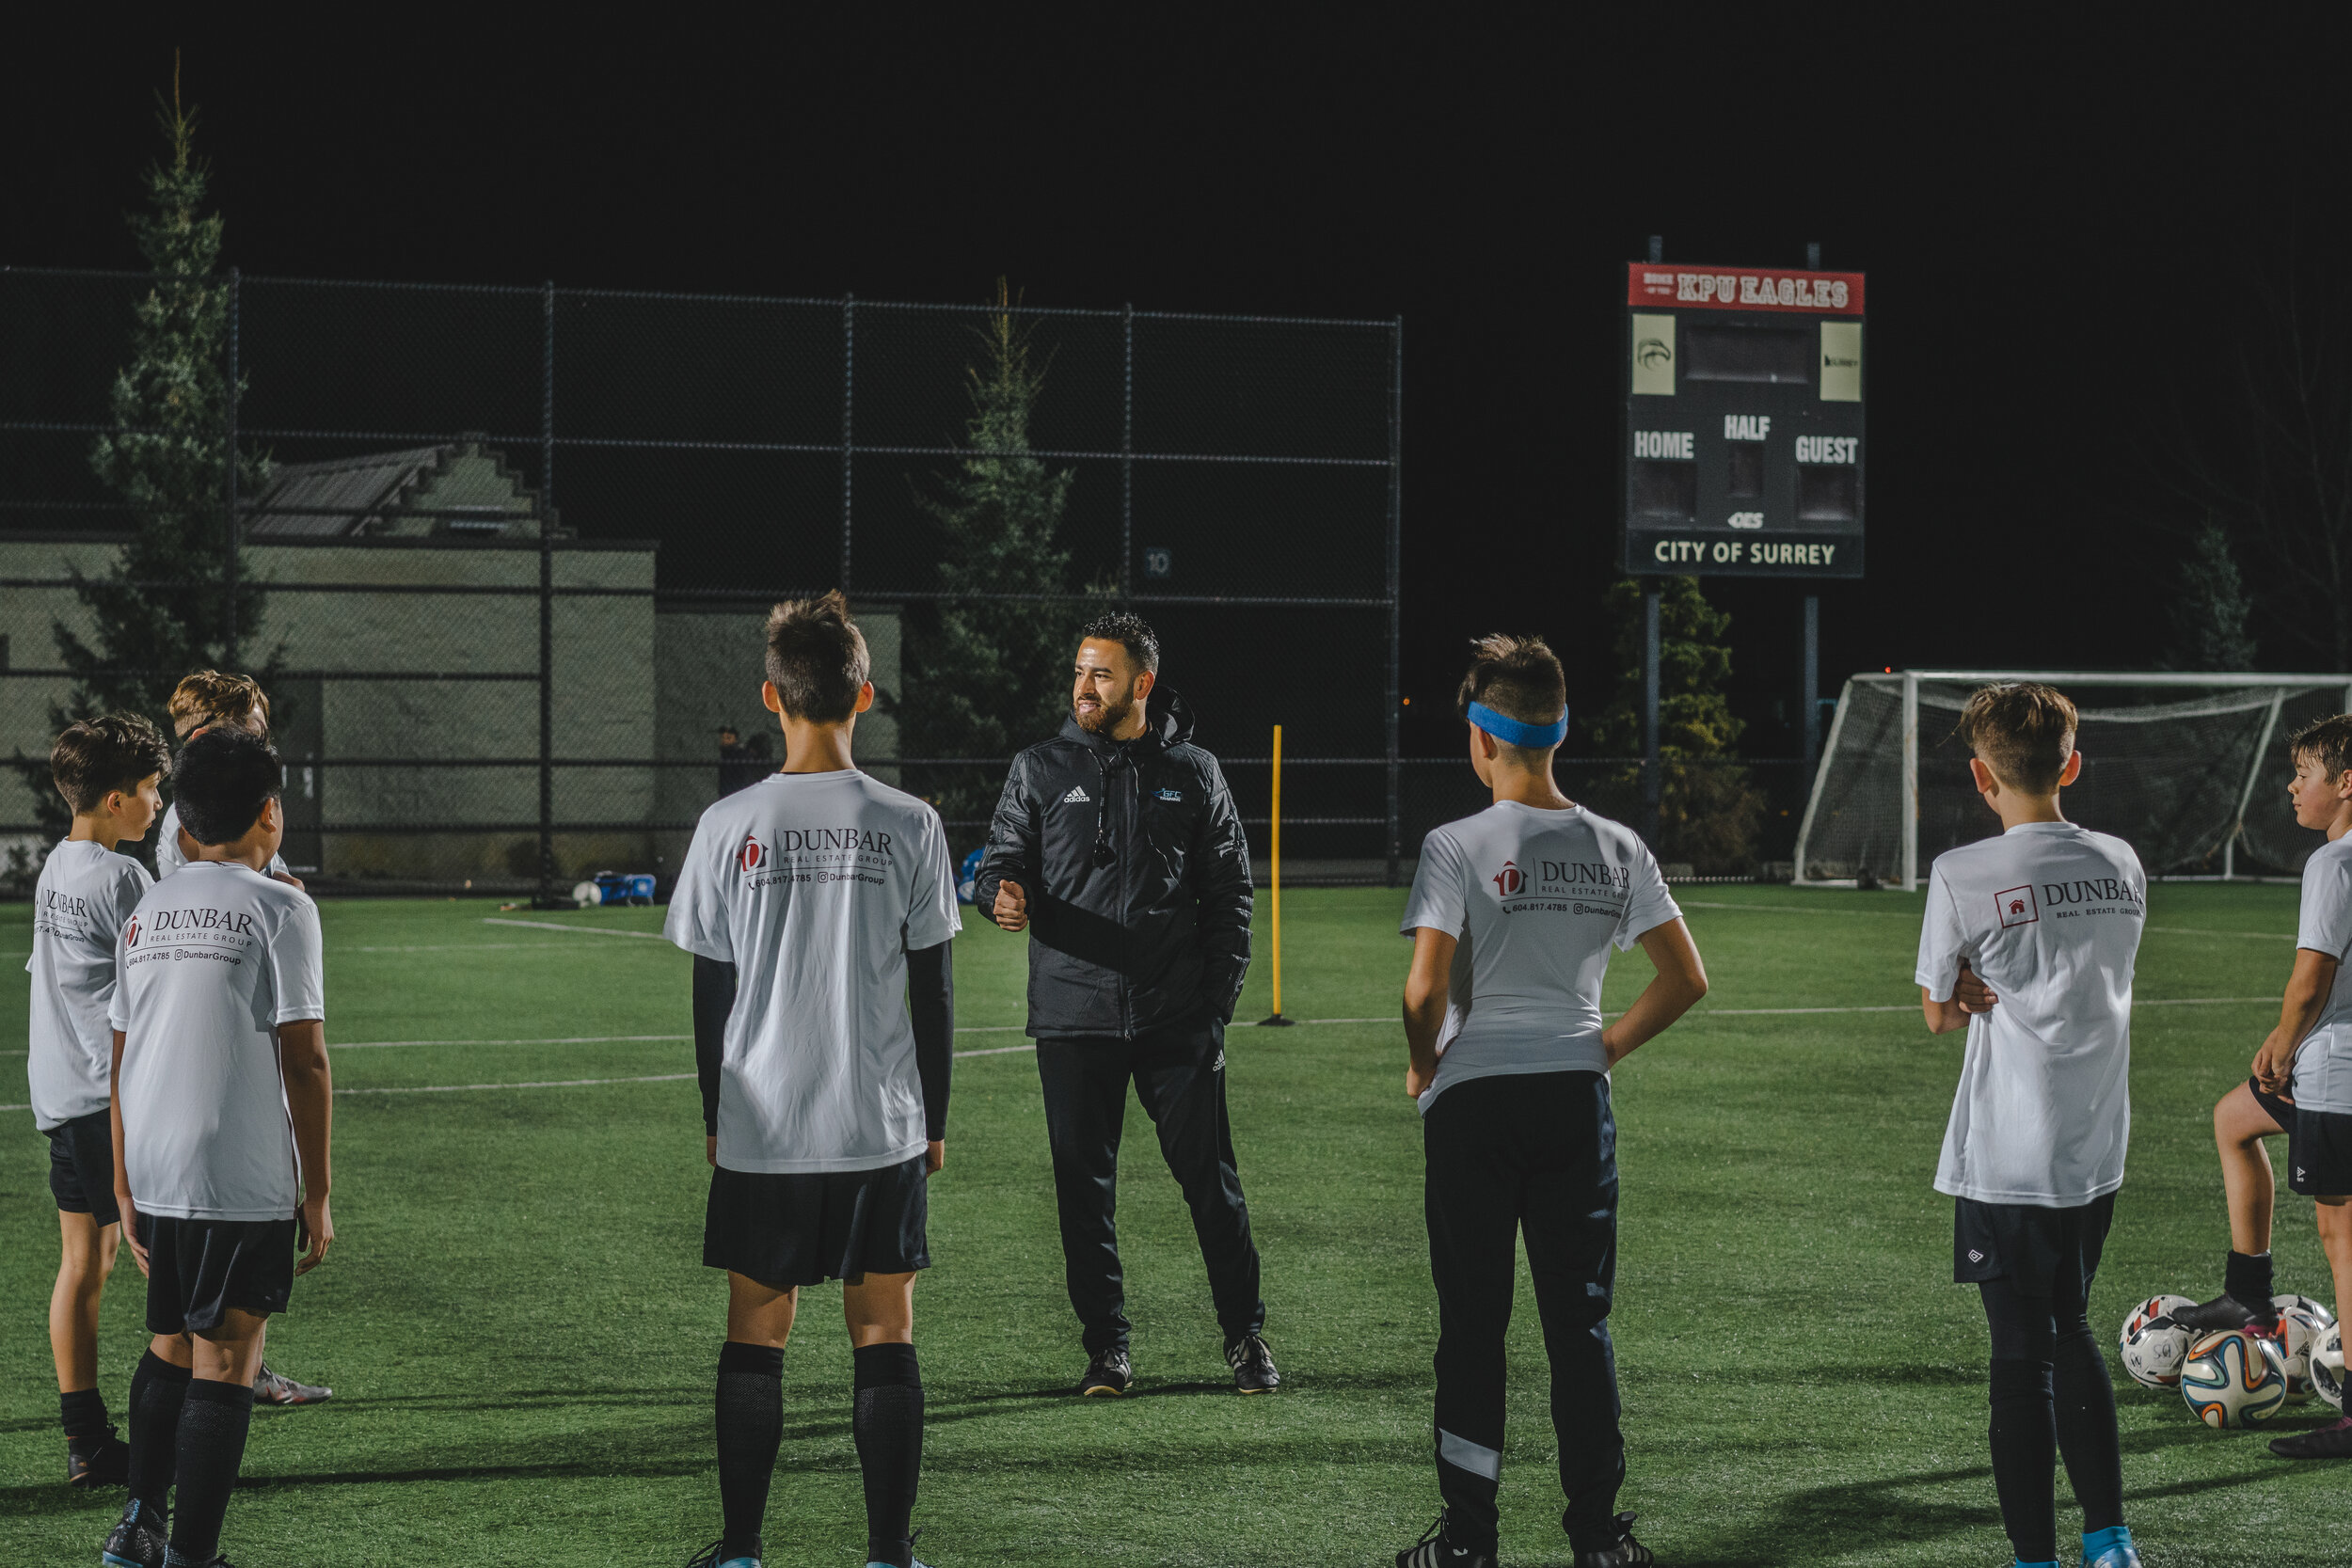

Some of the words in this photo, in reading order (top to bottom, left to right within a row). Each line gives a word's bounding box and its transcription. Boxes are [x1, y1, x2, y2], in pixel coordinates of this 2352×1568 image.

[1677, 273, 1737, 303] KPU
[1740, 277, 1849, 308] EAGLES
[1724, 415, 1771, 440] HALF
[1634, 431, 1694, 459] HOME
[1796, 436, 1858, 464] GUEST
[1655, 541, 1706, 562] CITY
[1712, 542, 1742, 562] OF
[1750, 542, 1836, 564] SURREY
[1063, 795, 1089, 803] adidas
[784, 828, 893, 856] DUNBAR
[784, 855, 810, 864] REAL
[816, 854, 852, 863] ESTATE
[857, 854, 893, 866] GROUP
[755, 873, 812, 887] 604.817.4785
[1541, 861, 1630, 890] DUNBAR
[1541, 885, 1566, 894] REAL
[1571, 887, 1609, 897] ESTATE
[1512, 903, 1567, 912] 604.817.4785
[2056, 910, 2081, 919] REAL
[2086, 907, 2117, 916] ESTATE
[153, 908, 253, 937] DUNBAR
[151, 933, 171, 942] REAL
[176, 932, 208, 941] ESTATE
[213, 933, 253, 948] GROUP
